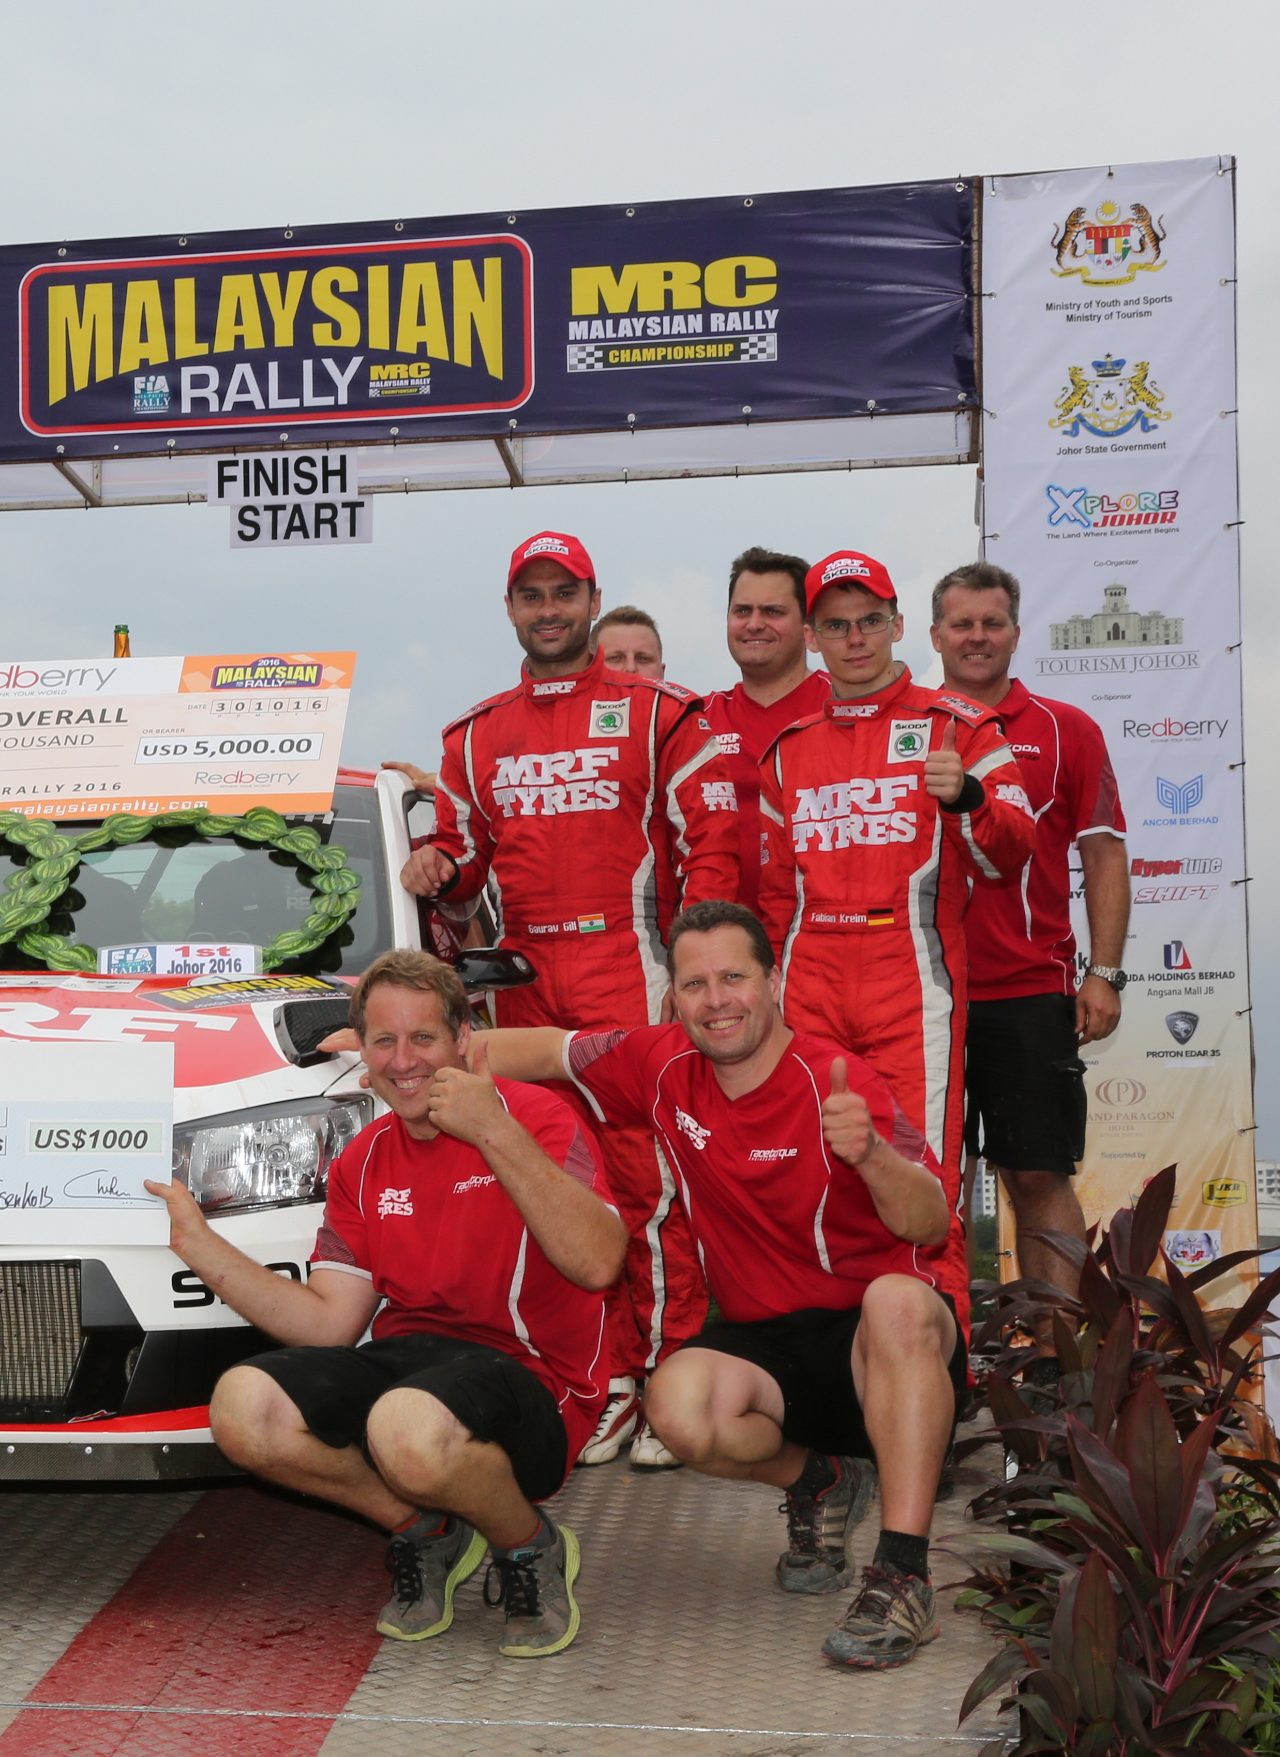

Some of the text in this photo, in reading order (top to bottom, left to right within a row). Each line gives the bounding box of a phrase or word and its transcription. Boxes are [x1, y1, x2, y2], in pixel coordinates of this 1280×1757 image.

[570, 255, 778, 316] MRC
[1045, 295, 1173, 312] Ministry of Youth and Sports
[568, 309, 780, 340] MALAYSIAN RALLY
[1066, 310, 1152, 323] Ministry of Tourism
[48, 257, 503, 407] MALAYSIAN
[608, 343, 735, 364] CHAMPIONSHIP
[370, 362, 430, 380] MRC
[180, 356, 364, 413] RALLY
[369, 378, 431, 388] MALAYSIAN RALLY
[133, 397, 170, 408] RALLY
[1056, 440, 1167, 456] Johor State Government
[217, 454, 347, 499] FINISH
[237, 501, 365, 542] START
[1093, 511, 1177, 528] JOHOR
[1110, 528, 1152, 537] Excitement
[1154, 526, 1180, 535] Begins
[1093, 558, 1139, 568] Co-Organizer
[257, 658, 280, 666] 2016
[1035, 652, 1200, 674] TOURISM JOHOR
[216, 665, 318, 687] MALAYSIAN
[244, 679, 286, 688] RALLY
[533, 681, 577, 696] MRF
[1091, 693, 1132, 702] Co-Sponsor
[832, 704, 879, 717] MRF
[1123, 717, 1229, 740] Redberry
[143, 738, 313, 758] USD 5,000.00
[492, 746, 619, 789] MRF
[194, 770, 300, 786] Redberry
[2, 783, 66, 796] RALLY
[72, 781, 122, 793] 2016
[492, 780, 620, 818] TYRES
[791, 774, 918, 823] MRF
[1143, 816, 1219, 827] ANCOM BERHAD
[792, 811, 917, 853] TYRES
[1134, 884, 1219, 904] SHIFT
[811, 912, 868, 924] Fabian Kreim
[528, 920, 577, 934] Gaurav Gill
[175, 946, 232, 957] 1st
[167, 958, 242, 974] Johor 2016
[1148, 970, 1236, 982] HOLDINGS BERHAD
[159, 976, 336, 1004] MALAYSIAN
[1147, 986, 1215, 999] Angsana Mall JB
[1146, 1049, 1209, 1059] PROTON EDAR
[1115, 1111, 1175, 1121] PARAGON
[34, 1128, 149, 1151] US$1000
[748, 1147, 798, 1160] racetorque
[1101, 1152, 1136, 1160] Supported
